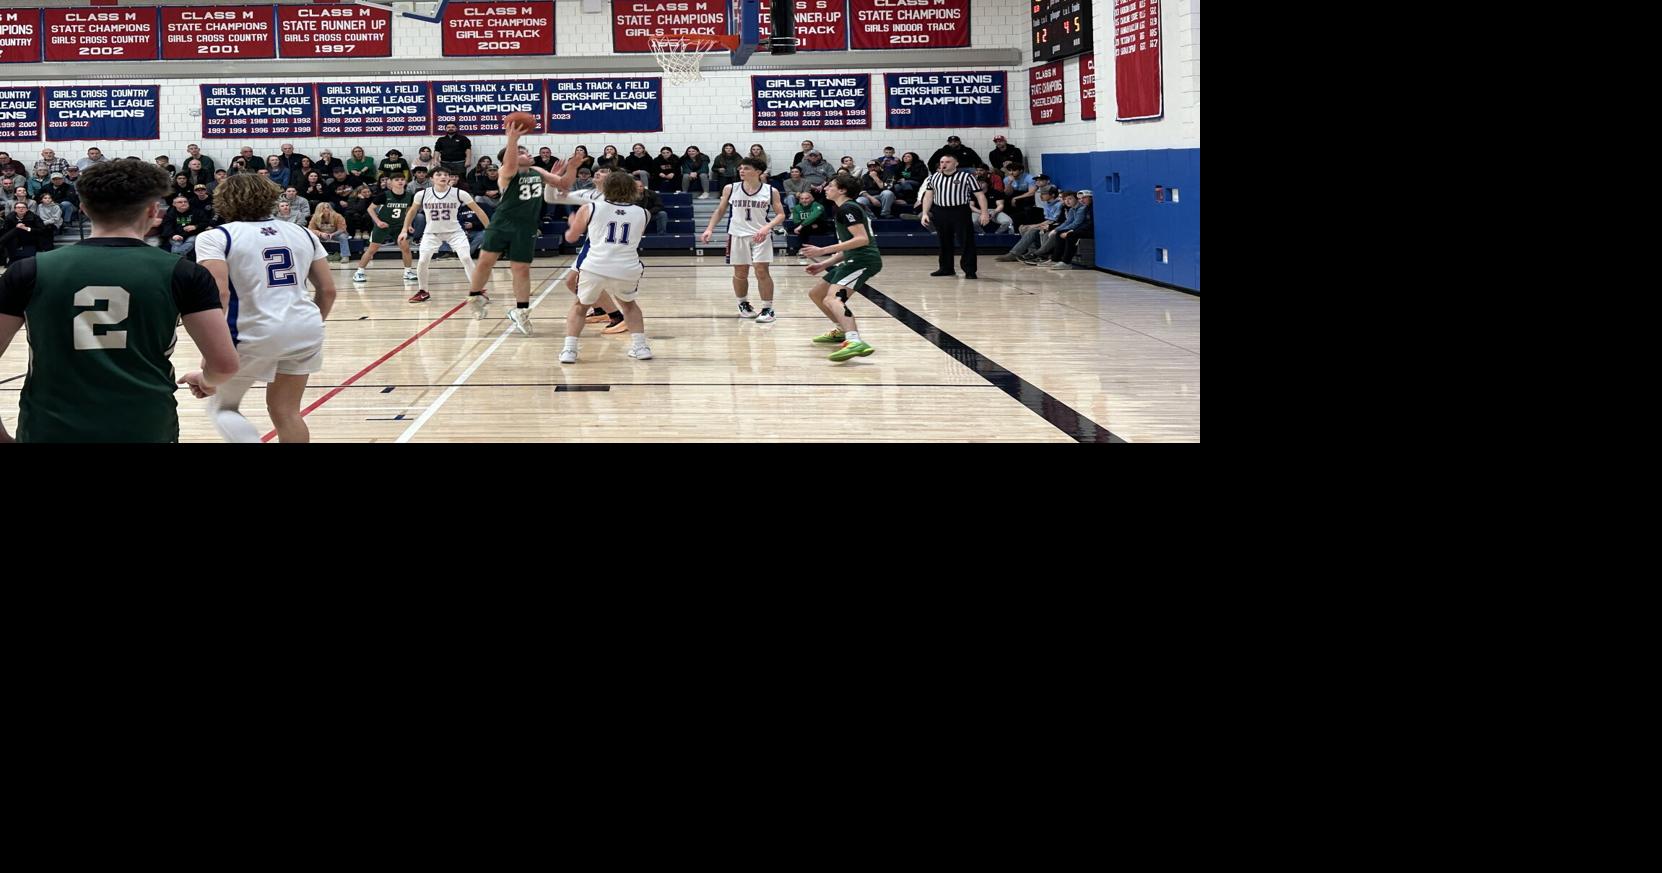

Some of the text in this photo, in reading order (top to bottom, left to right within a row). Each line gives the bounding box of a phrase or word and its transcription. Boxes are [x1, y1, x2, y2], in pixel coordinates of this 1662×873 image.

[298, 8, 371, 17] CLASS M
[464, 7, 532, 16] CLASS M
[632, 3, 688, 12] CLASS
[6, 13, 17, 21] M
[65, 13, 136, 21] CLASS M
[181, 11, 254, 20] CLASS M
[617, 13, 724, 25] STATE CHAMPIONS
[858, 9, 961, 20] STATE CHAMPIONS
[168, 22, 267, 31] STATE CHAMPIONS
[282, 20, 386, 31] STATE RUNNER UP
[449, 18, 547, 28] STATE CHAMPIONS
[864, 23, 955, 32] GIRLS INDOOR TRACK
[0, 24, 33, 35] PIONS
[51, 24, 150, 33] STATE CHAMPIONS
[625, 27, 716, 37] GIRLS TRACK
[167, 33, 268, 43] GIRLS CROSS COUNTRY
[284, 33, 385, 42] GIRLS CROSS COUNTRY
[456, 29, 540, 39] GIRLS TRACK
[889, 35, 929, 43] 2010
[51, 35, 150, 44] GIRLS CROSS COUNTRY
[79, 47, 124, 55] 2002
[197, 45, 240, 53] 2001
[314, 44, 356, 53] 1997
[478, 42, 520, 50] 2003
[766, 78, 856, 88] GIRLS TENNIS
[899, 75, 992, 85] GIRLS TENNIS
[327, 86, 351, 94] GIRLS
[354, 86, 381, 94] TRACK
[395, 85, 419, 93] FIELD
[442, 84, 466, 93] GIRLS
[469, 84, 496, 92] TRACK
[510, 83, 534, 92] FIELD
[558, 83, 582, 91] GIRLS
[585, 82, 613, 90] TRACK
[625, 81, 650, 89] FIELD
[890, 85, 1002, 96] BERKSHIRE LEAGUE
[53, 89, 149, 98] GIRLS CROSS COUNTRY
[212, 87, 236, 96] GIRLS
[240, 87, 267, 95] TRACK
[280, 87, 304, 95] FIELD
[551, 91, 656, 101] BERKSHIRE LEAGUE
[758, 88, 864, 98] BERKSHIRE LEAGUE
[206, 97, 311, 106] BERKSHIRE LEAGUE
[322, 95, 425, 105] BERKSHIRE LEAGUE
[436, 93, 540, 103] BERKSHIRE LEAGUE
[901, 96, 992, 106] CHAMPIONS
[49, 100, 154, 109] BERKSHIRE LEAGUE
[445, 104, 532, 113] CHAMPIONS
[561, 102, 648, 111] CHAMPIONS
[767, 99, 856, 109] CHAMPIONS
[58, 109, 145, 119] CHAMPIONS
[216, 107, 303, 116] CHAMPIONS
[330, 106, 417, 115] CHAMPIONS
[519, 183, 542, 200] 33
[391, 208, 401, 218] 3
[430, 209, 451, 221] 23
[745, 208, 751, 221] 1
[605, 221, 631, 245] 11
[262, 246, 298, 288] 2
[73, 285, 130, 350] 2
